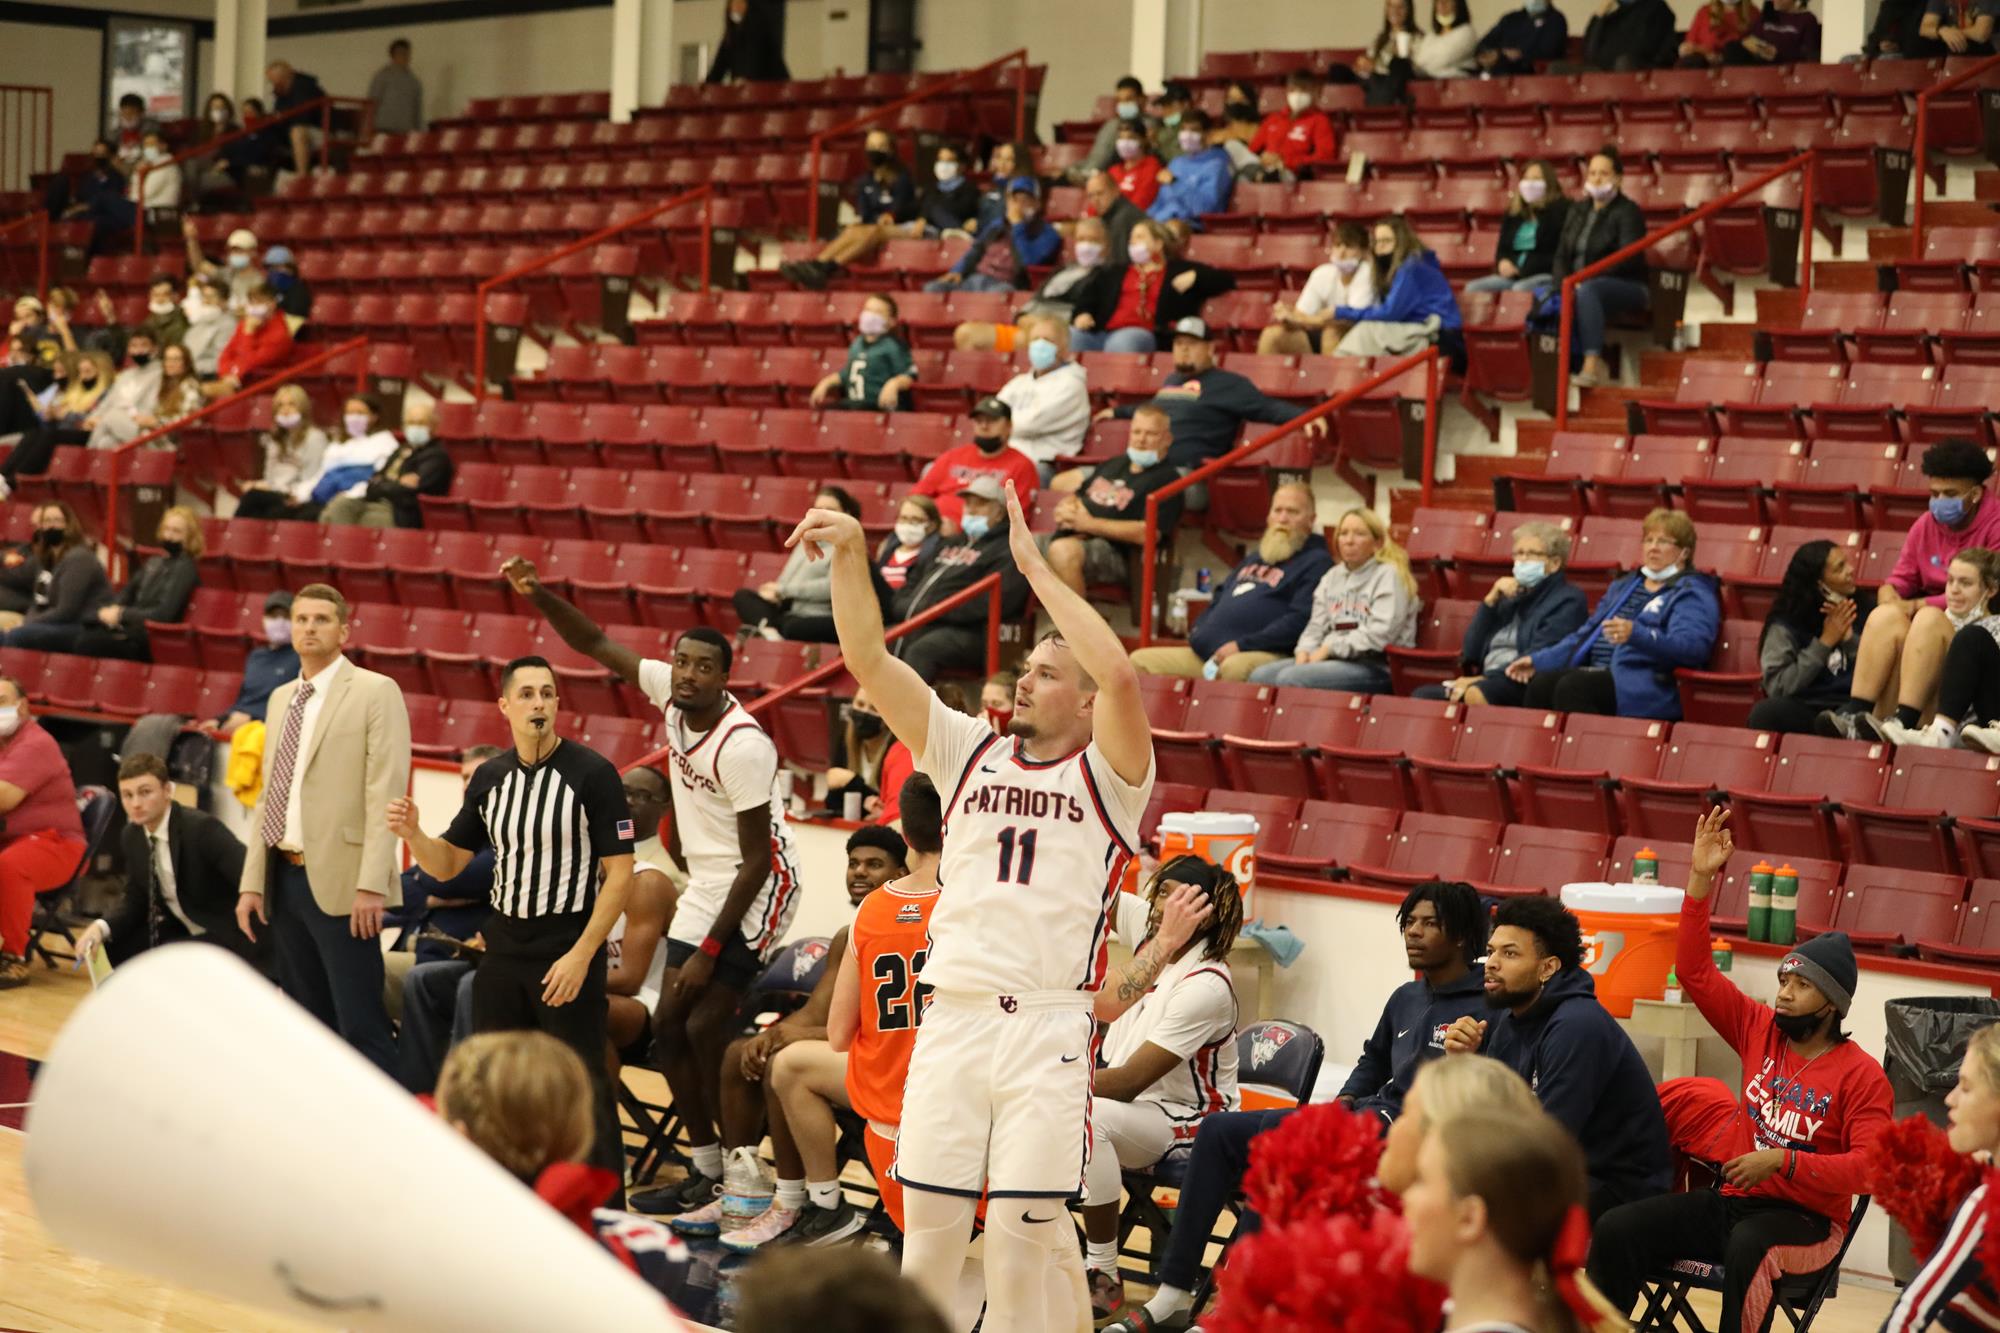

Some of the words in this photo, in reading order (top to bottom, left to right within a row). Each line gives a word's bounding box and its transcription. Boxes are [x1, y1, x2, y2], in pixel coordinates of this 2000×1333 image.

[848, 360, 867, 400] 5
[964, 785, 1084, 823] PATRIOTS
[997, 826, 1037, 885] 11
[998, 995, 1018, 1014] UC
